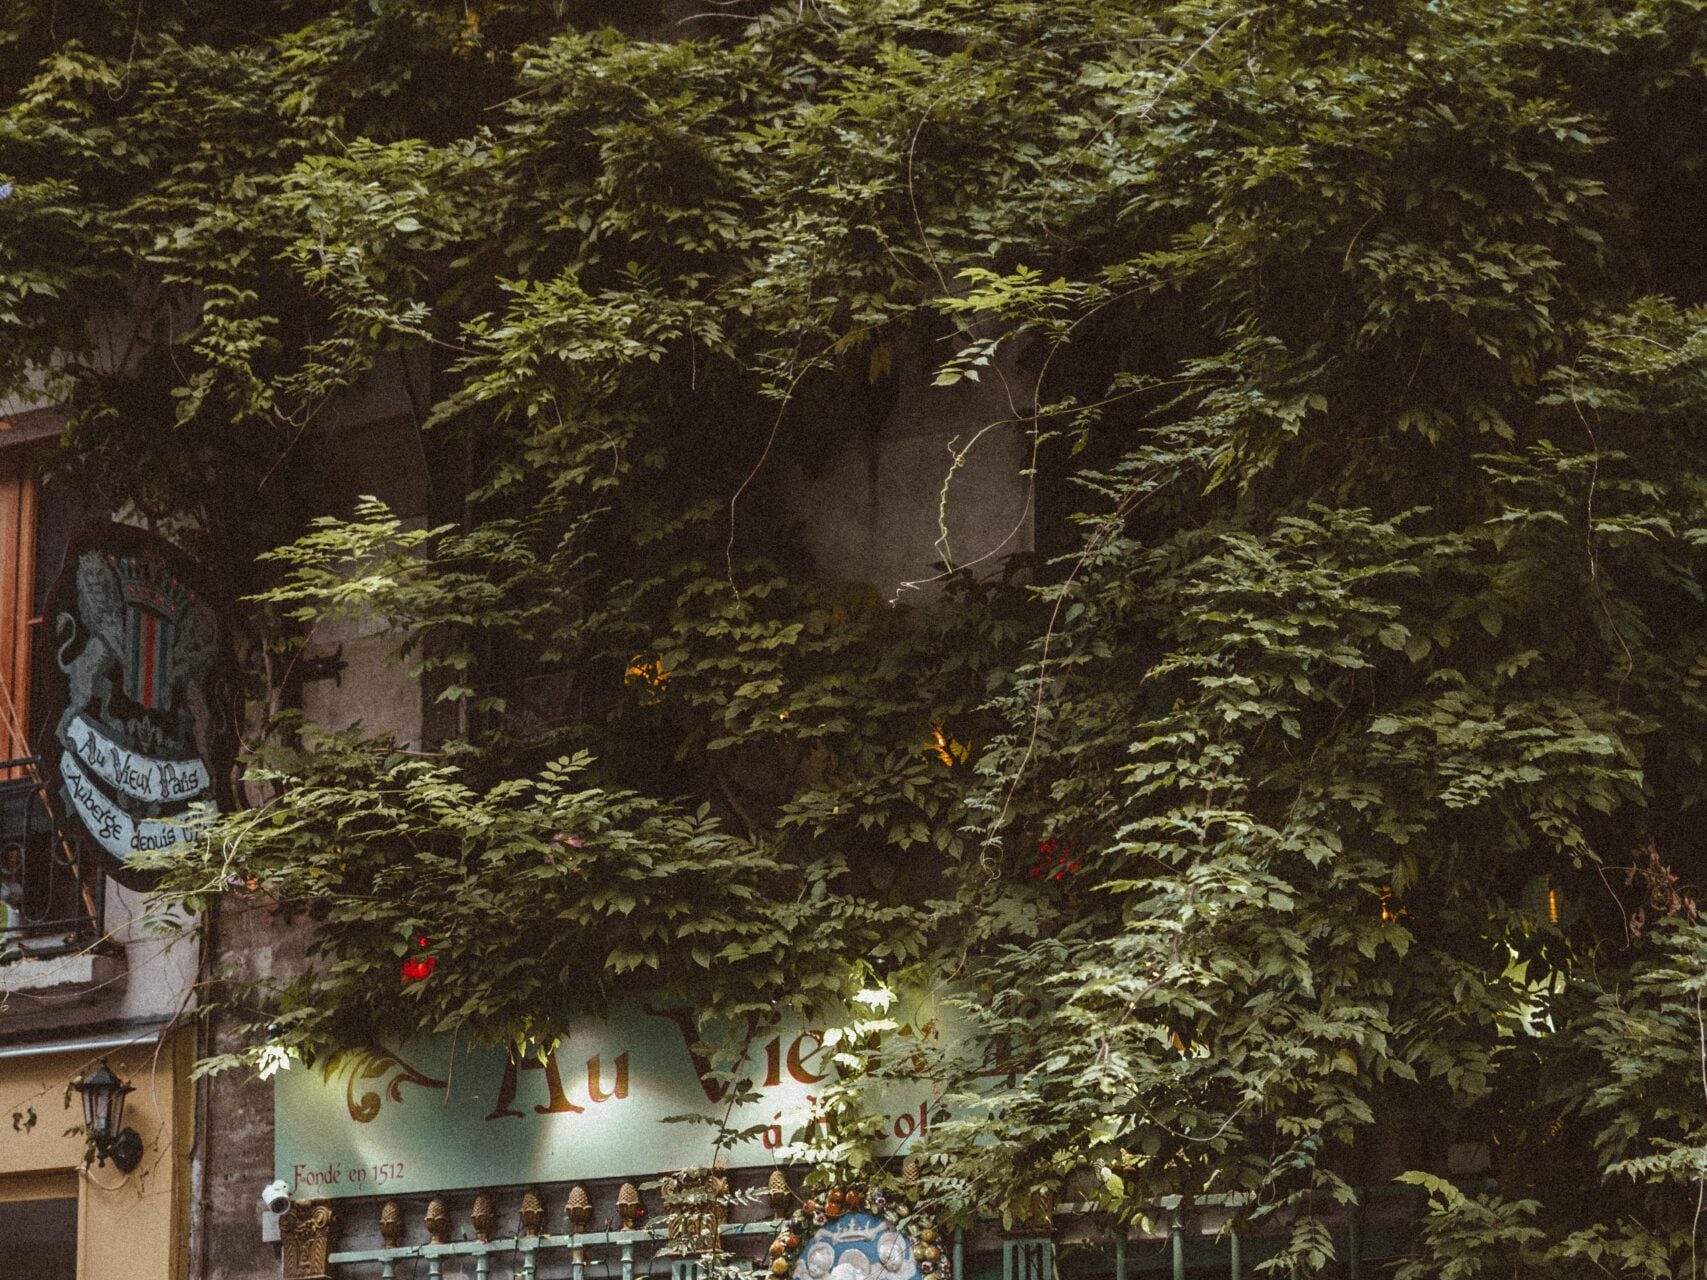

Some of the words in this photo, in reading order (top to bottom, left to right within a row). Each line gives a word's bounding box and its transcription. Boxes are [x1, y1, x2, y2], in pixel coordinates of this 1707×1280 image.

[79, 731, 104, 766] Au
[111, 746, 151, 794] Vieux
[156, 763, 199, 798] Paris
[68, 774, 122, 840] Auberge
[485, 1030, 629, 1121] Au
[642, 1003, 938, 1104] Vie
[288, 1163, 341, 1195] Fondé
[374, 1163, 404, 1185] 1512
